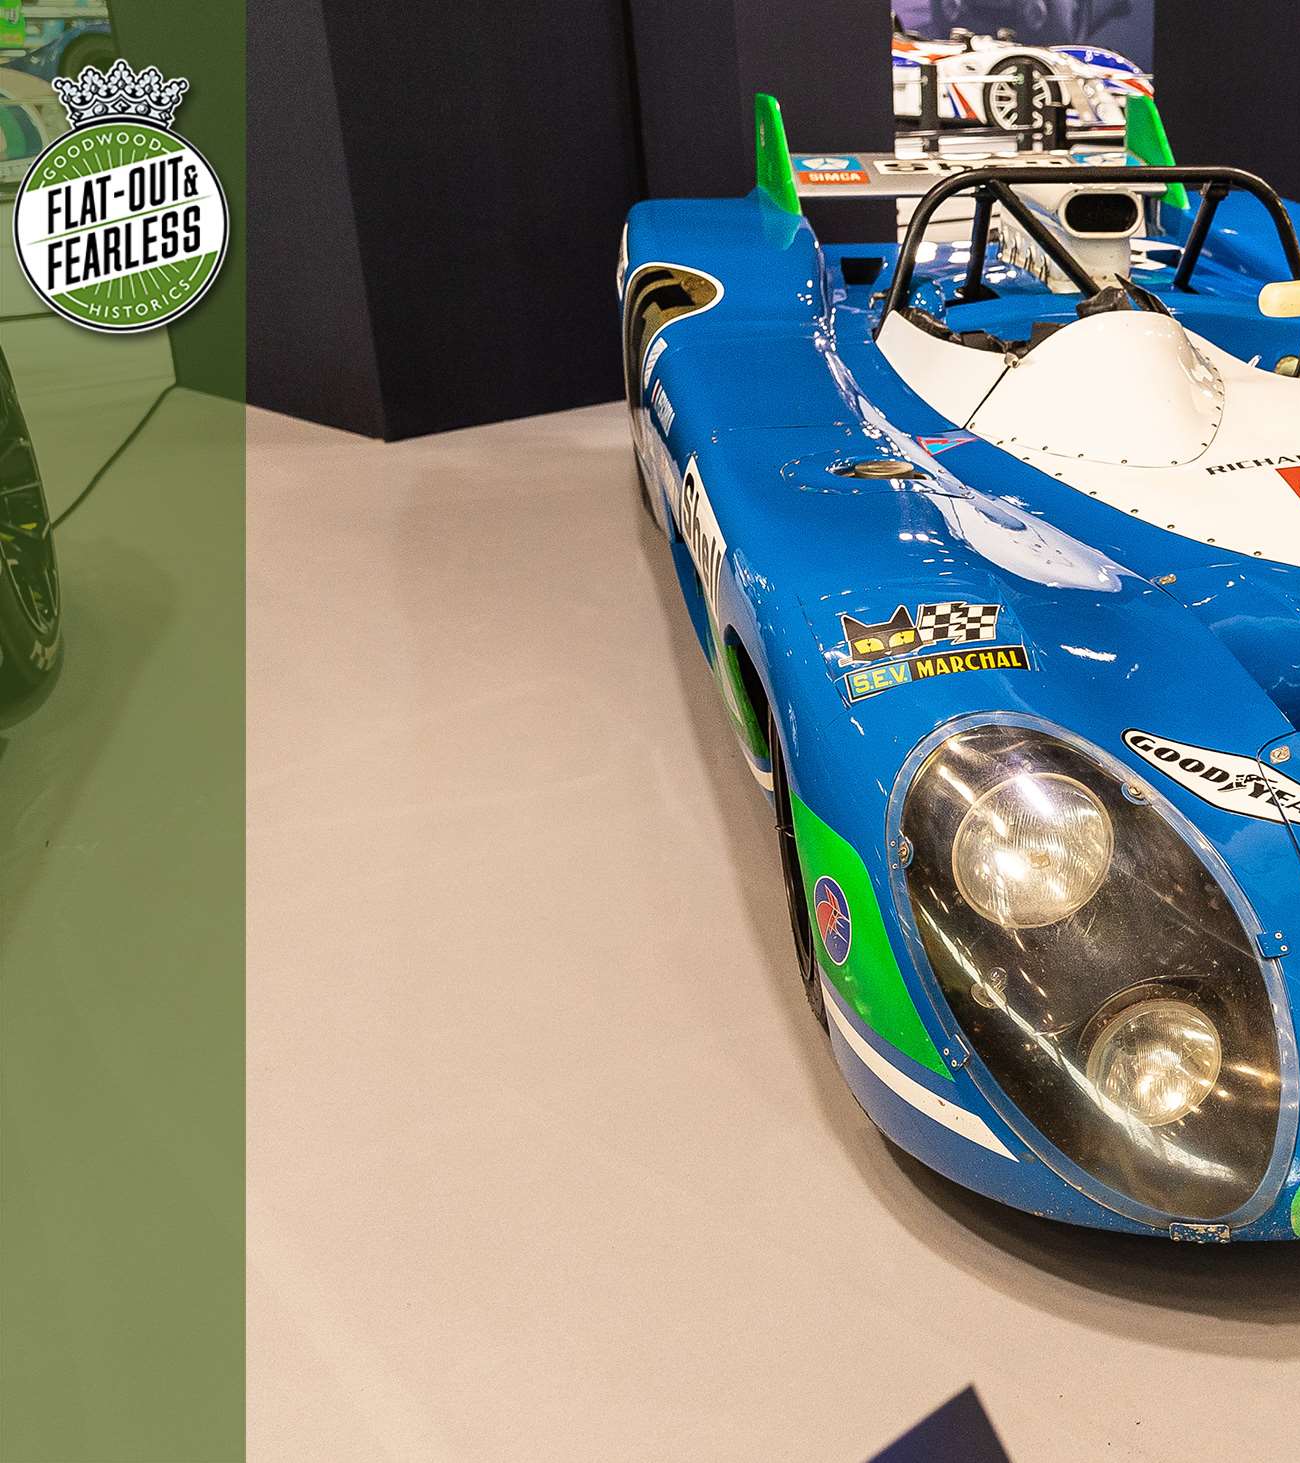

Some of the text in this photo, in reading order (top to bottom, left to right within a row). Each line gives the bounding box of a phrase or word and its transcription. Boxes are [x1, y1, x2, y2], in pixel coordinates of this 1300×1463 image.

[809, 173, 860, 182] SIMCA
[683, 472, 722, 616] Shell
[853, 650, 1022, 694] S.E.V. MARCHAL
